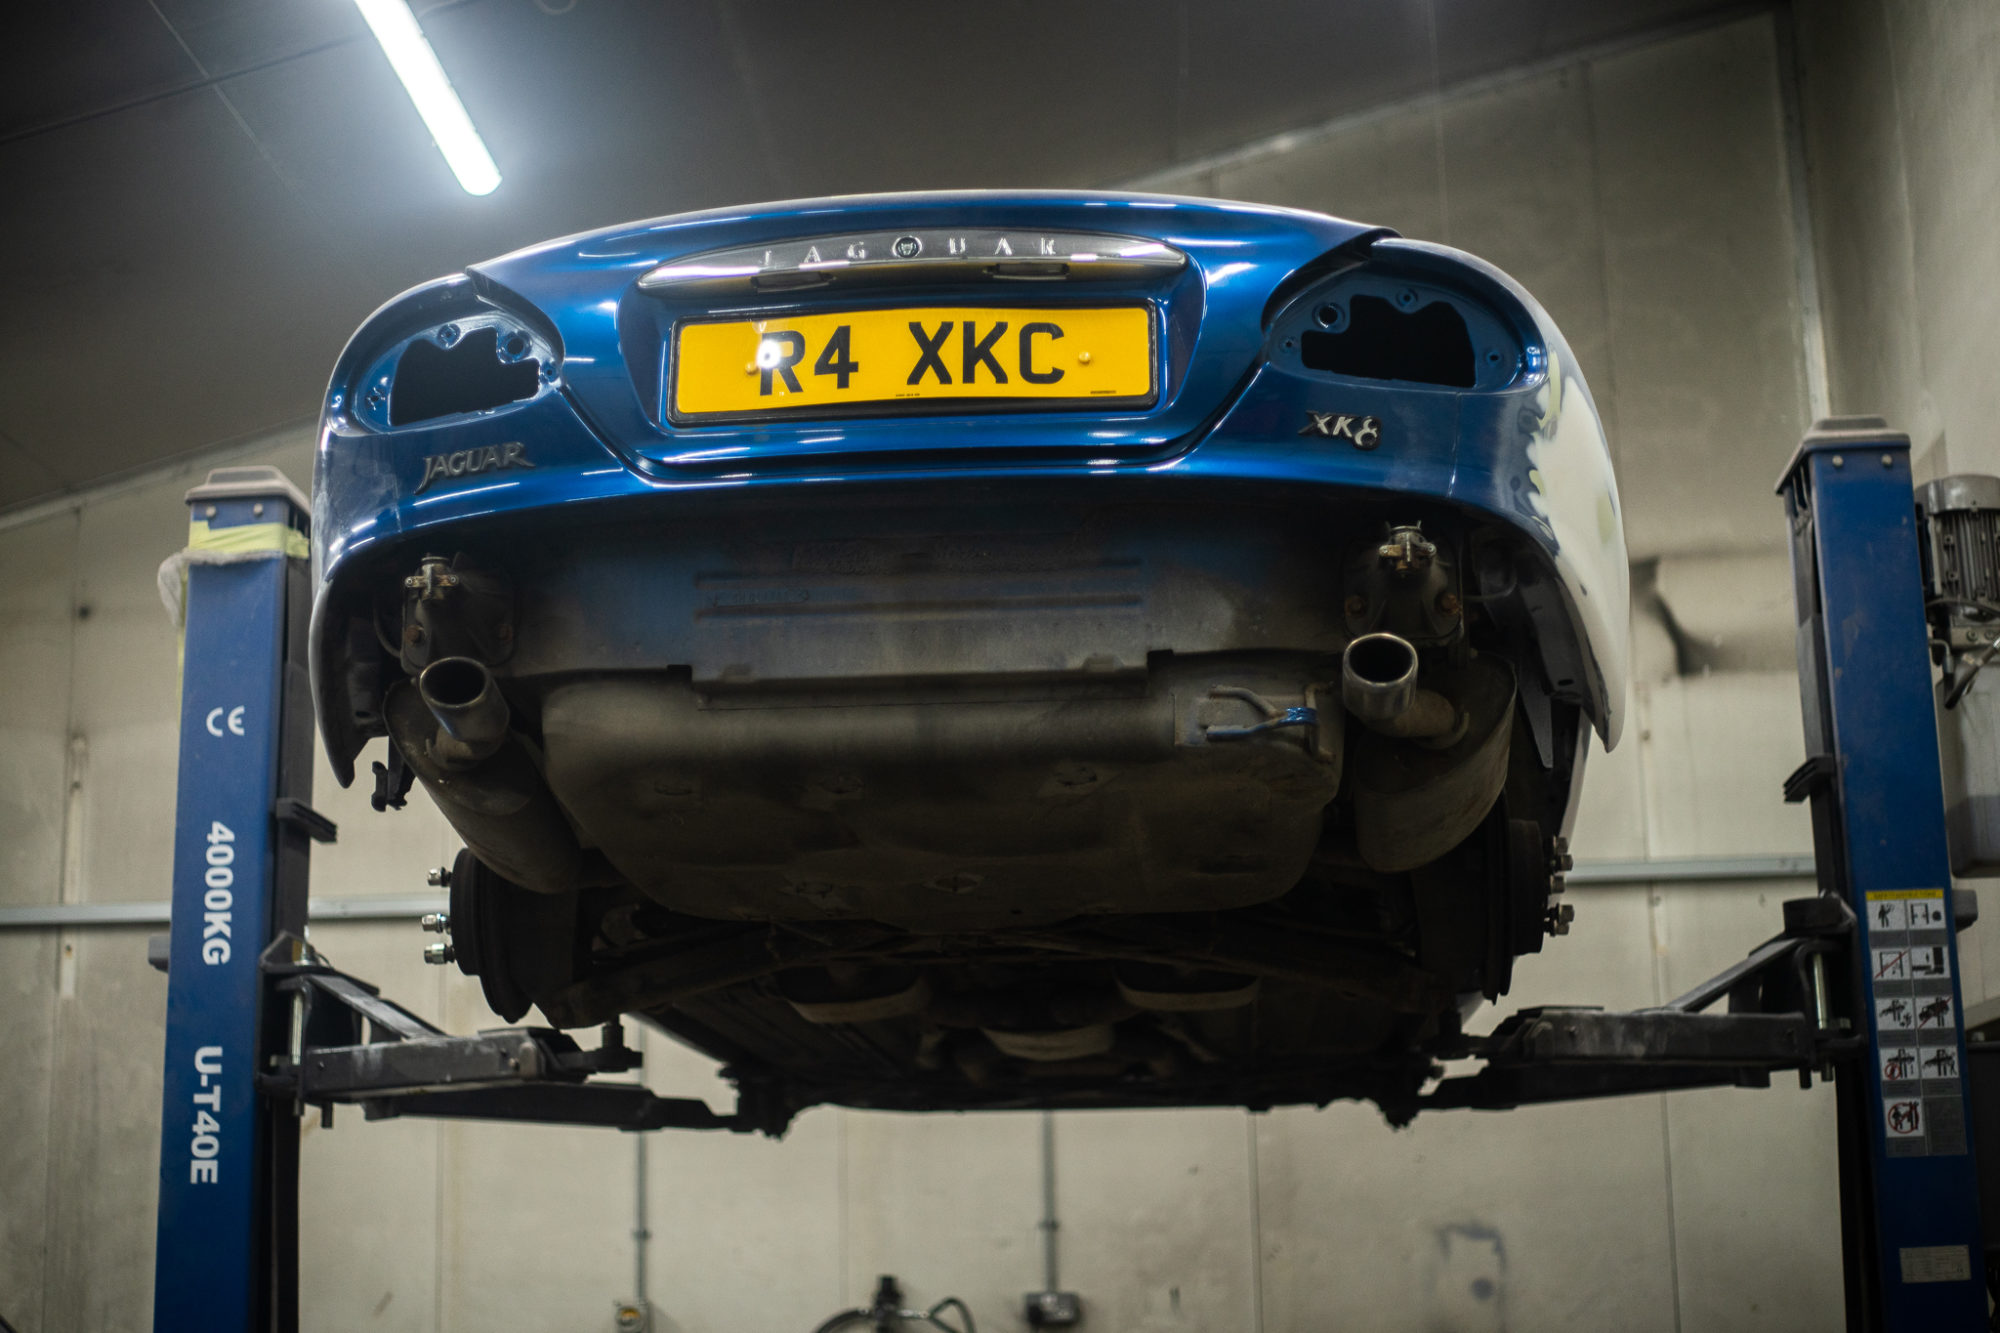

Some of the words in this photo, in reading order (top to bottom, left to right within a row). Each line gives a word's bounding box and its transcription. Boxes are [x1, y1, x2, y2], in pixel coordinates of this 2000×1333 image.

[762, 236, 1057, 266] JAGUAR
[760, 325, 859, 396] R4
[907, 320, 1065, 385] XKC
[1298, 410, 1381, 450] XK8
[414, 441, 536, 495] JAGUAR
[206, 705, 245, 737] CE
[202, 820, 235, 966] 4000KG
[190, 1045, 223, 1185] U-T40E
